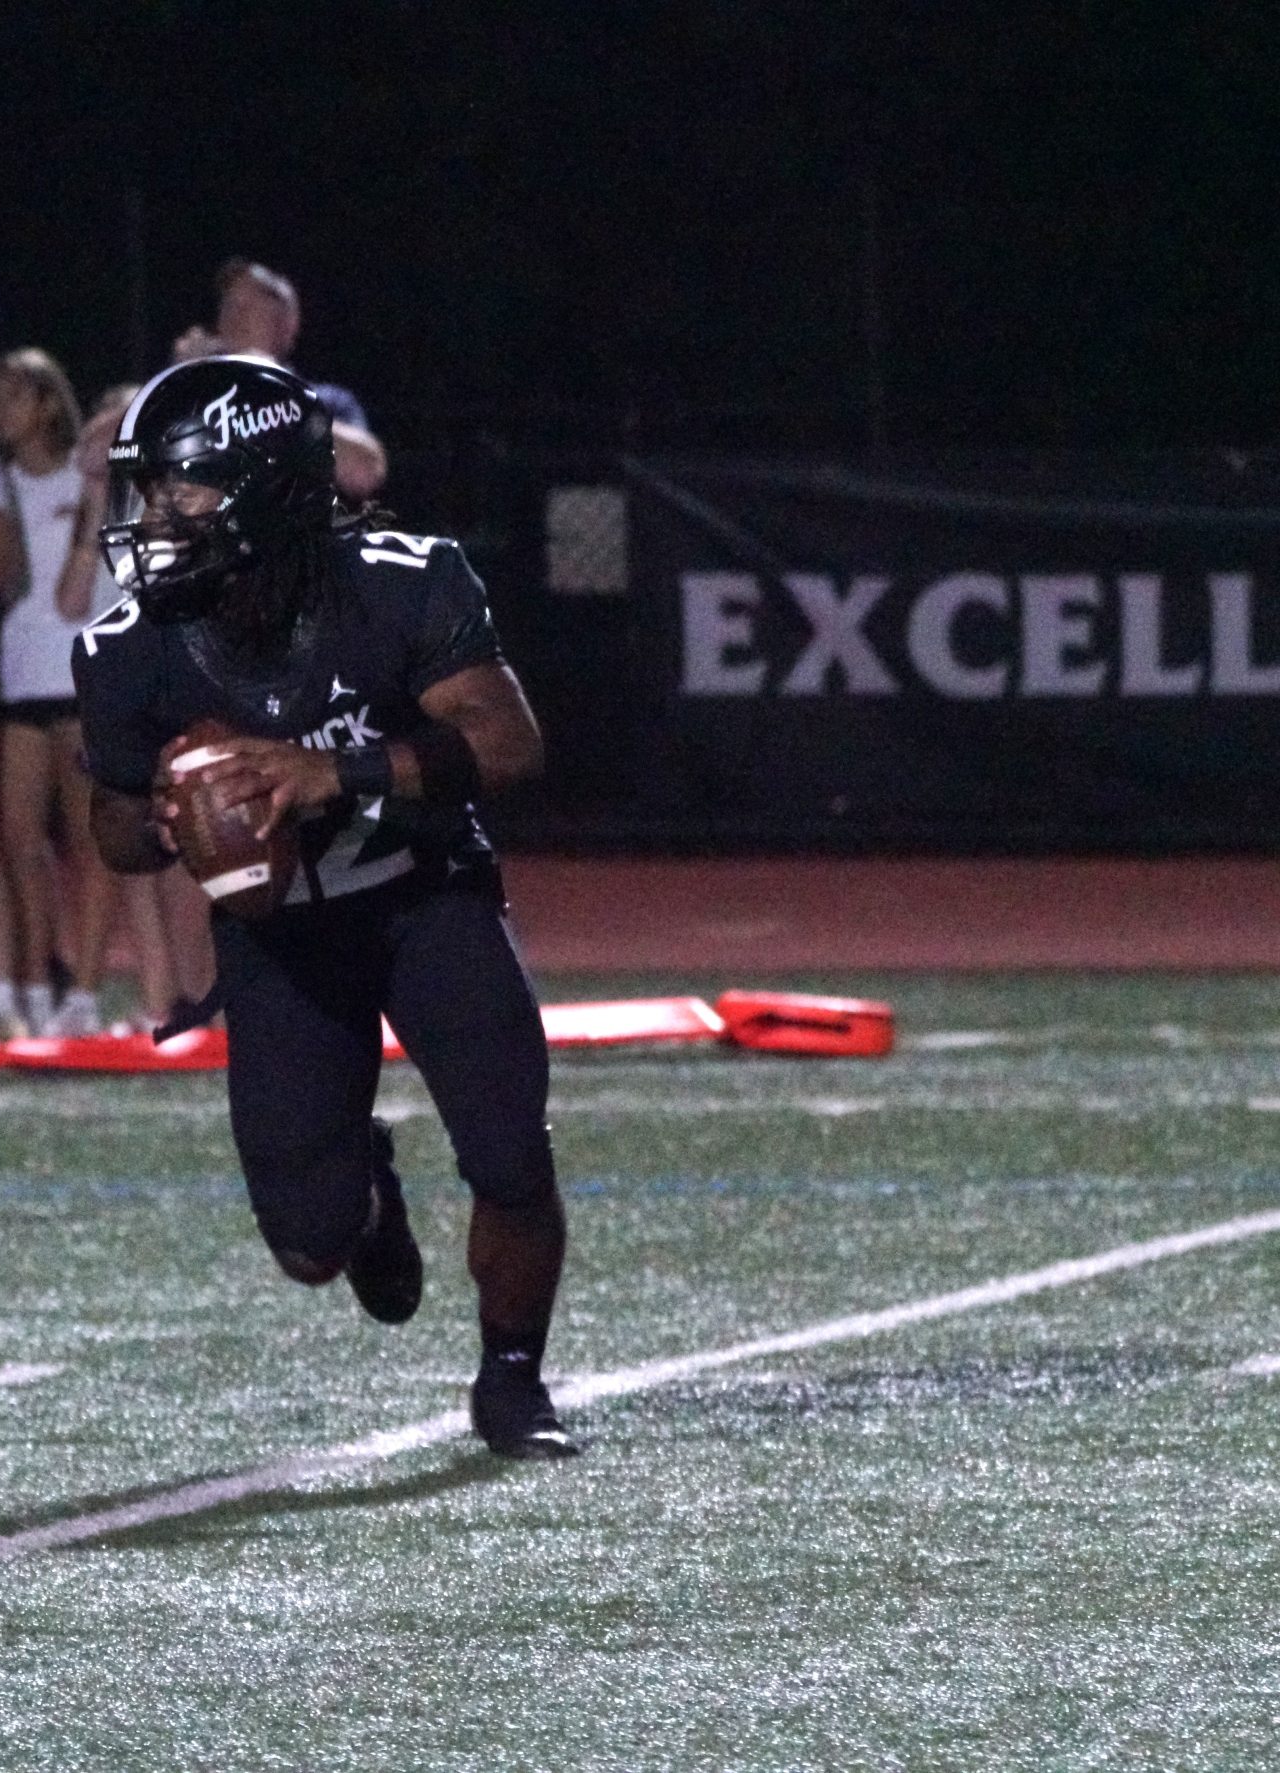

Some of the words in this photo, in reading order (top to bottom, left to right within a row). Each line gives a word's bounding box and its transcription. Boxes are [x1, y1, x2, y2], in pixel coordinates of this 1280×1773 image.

[203, 384, 301, 450] Friars
[360, 531, 438, 569] 12
[680, 573, 1280, 696] EXCELL
